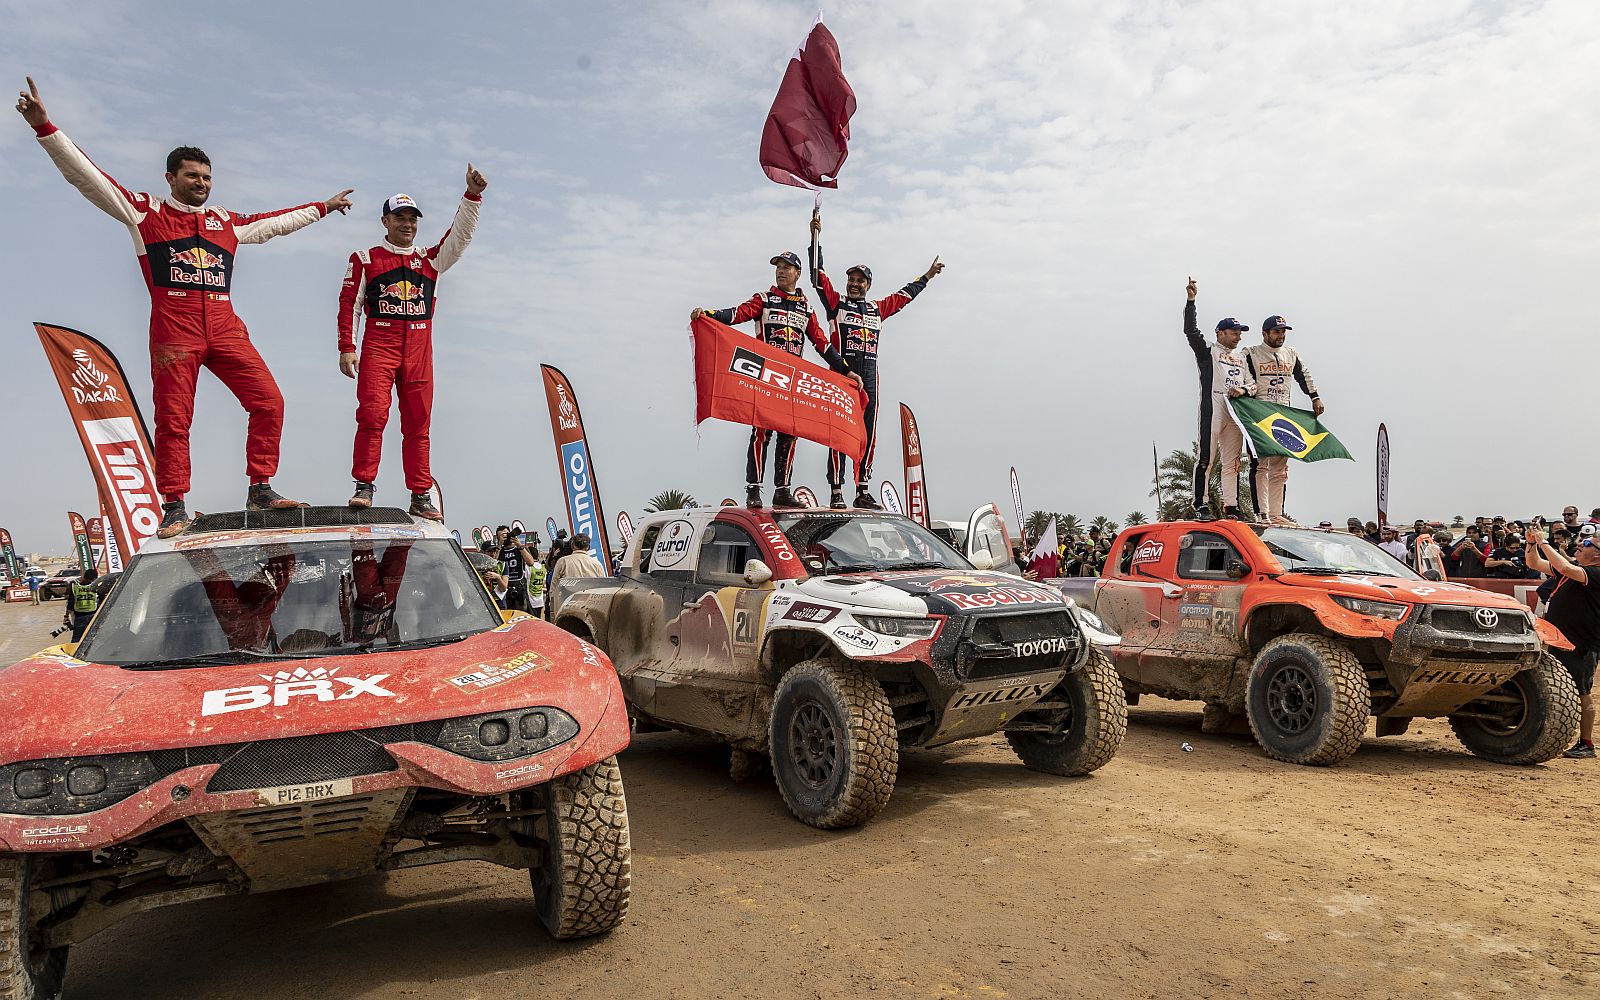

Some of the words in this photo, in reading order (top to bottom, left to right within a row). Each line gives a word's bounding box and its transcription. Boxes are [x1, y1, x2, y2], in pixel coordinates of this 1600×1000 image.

[170, 267, 203, 284] Red
[204, 269, 226, 288] Bull
[379, 300, 406, 315] Red
[407, 301, 426, 316] Bull
[846, 340, 864, 352] Red
[733, 359, 791, 390] GR
[71, 386, 123, 405] DAKAR
[776, 392, 789, 402] the
[792, 397, 817, 409] limits
[820, 403, 833, 414] for
[796, 387, 853, 416] Racing
[105, 447, 160, 550] OTUL
[657, 536, 689, 552] eurol
[76, 593, 94, 602] 212
[937, 587, 1018, 611] Red
[1002, 587, 1063, 605] Bull
[1181, 606, 1210, 616] aramco
[736, 611, 757, 644] 20
[837, 631, 874, 651] eurol
[1013, 637, 1067, 658] TOYOTA
[457, 674, 482, 685] 201
[1412, 670, 1510, 685] HILUX
[201, 673, 397, 717] BRX
[952, 682, 1053, 709] HILUX
[496, 764, 544, 780] prodrive
[23, 825, 87, 838] prodrive
[27, 837, 81, 846] INTERNATIONAL
